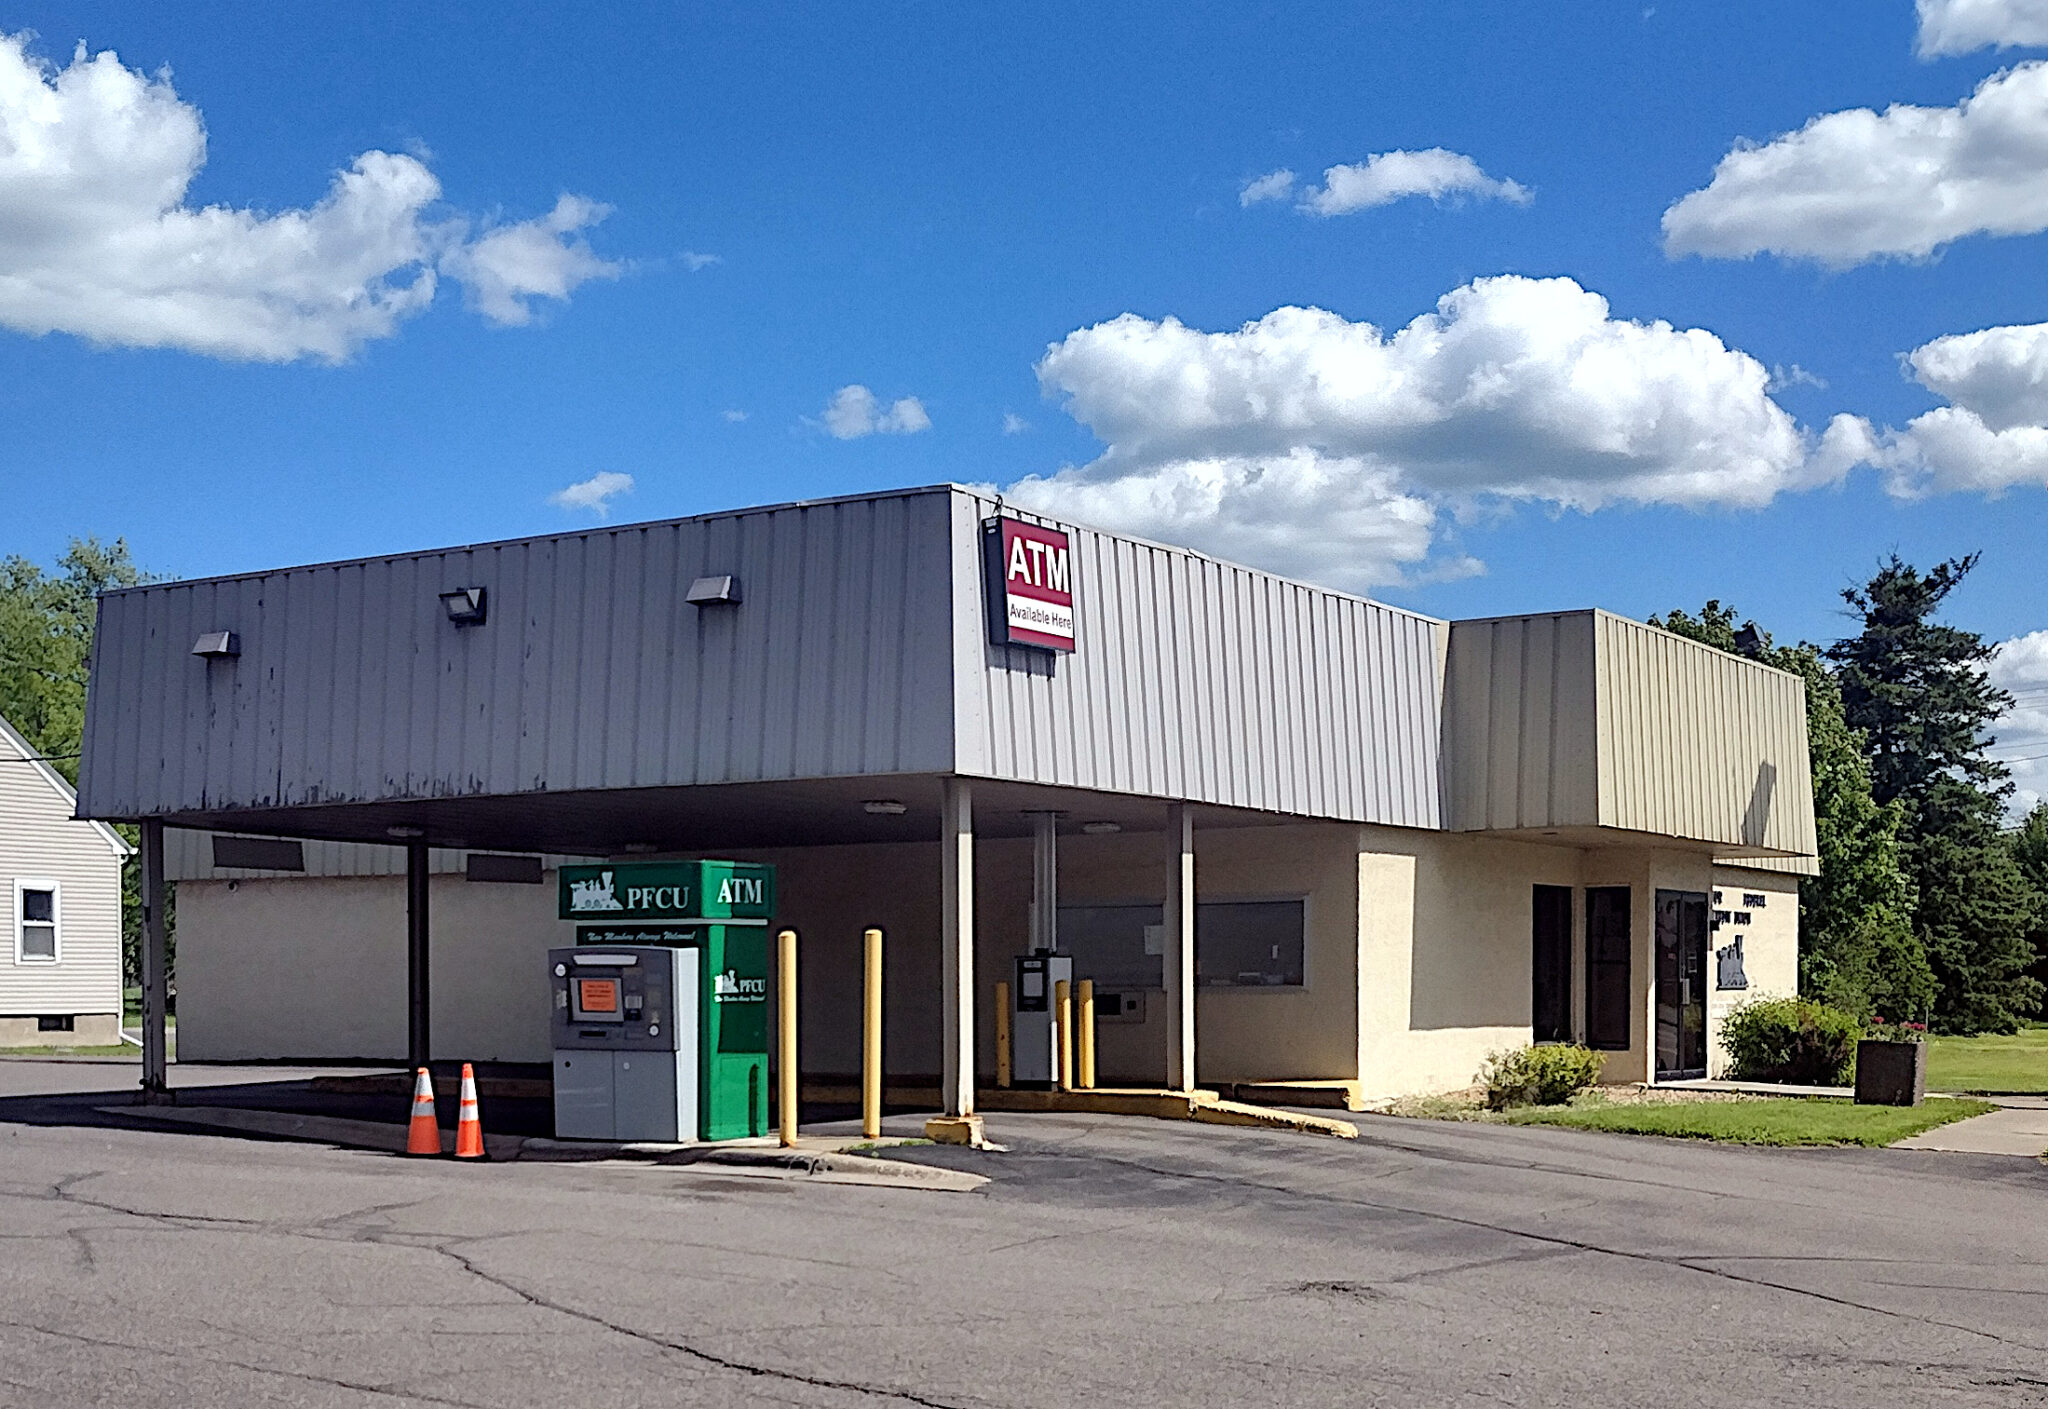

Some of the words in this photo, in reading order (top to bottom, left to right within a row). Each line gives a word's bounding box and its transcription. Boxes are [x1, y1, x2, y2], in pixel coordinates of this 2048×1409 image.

[1008, 536, 1070, 594] ATM
[1010, 603, 1050, 626] Available
[1051, 612, 1072, 630] Here
[627, 886, 690, 910] PFCU
[717, 878, 762, 904] ATM
[739, 978, 766, 993] PFCU
